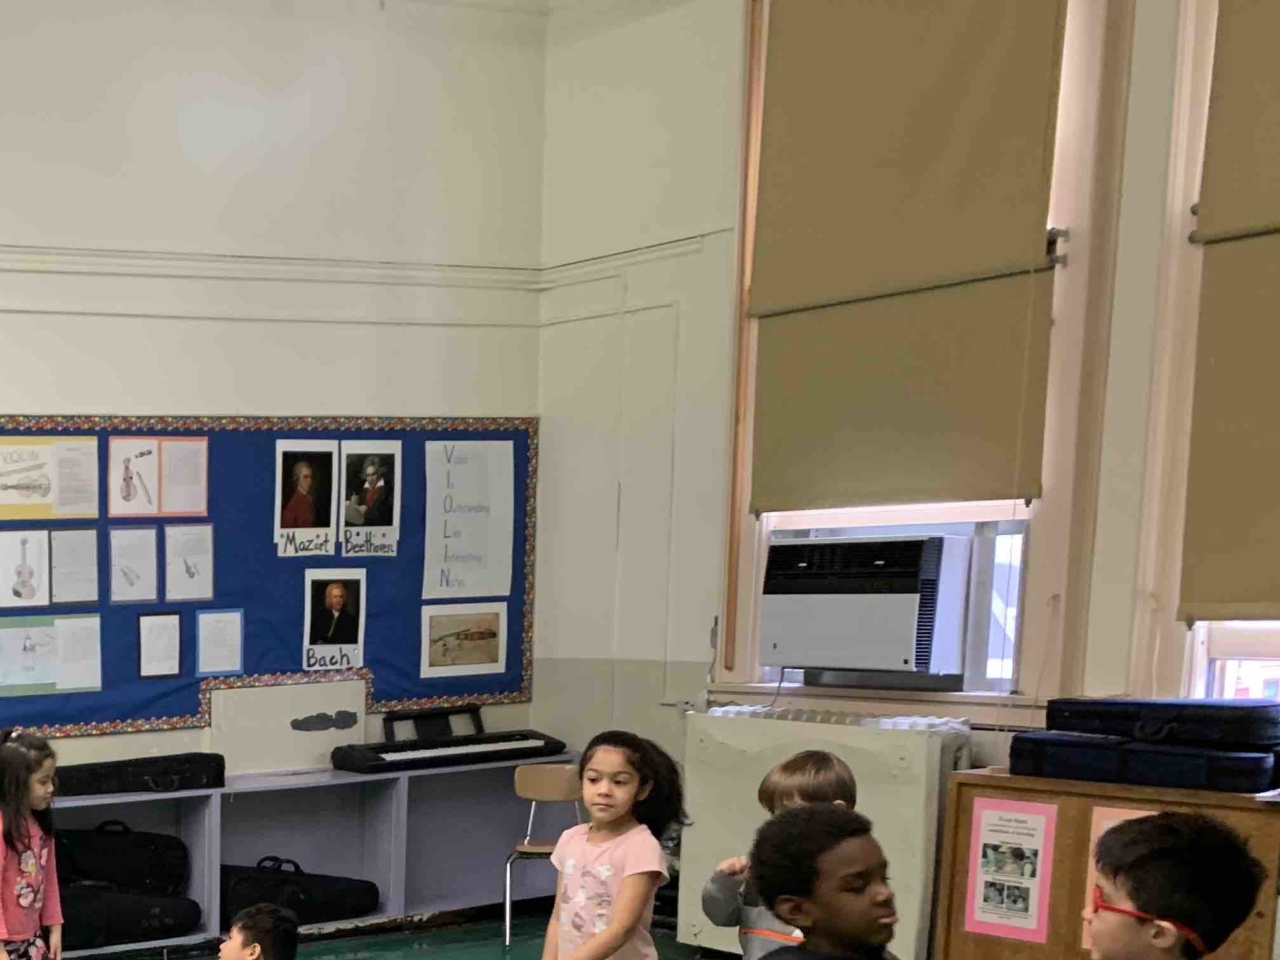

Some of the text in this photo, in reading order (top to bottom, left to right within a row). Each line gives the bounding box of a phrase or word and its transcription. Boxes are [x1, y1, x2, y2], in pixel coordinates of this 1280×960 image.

[283, 531, 329, 554] Mozart
[344, 529, 395, 554] Beethoven
[306, 646, 351, 668] Bach
